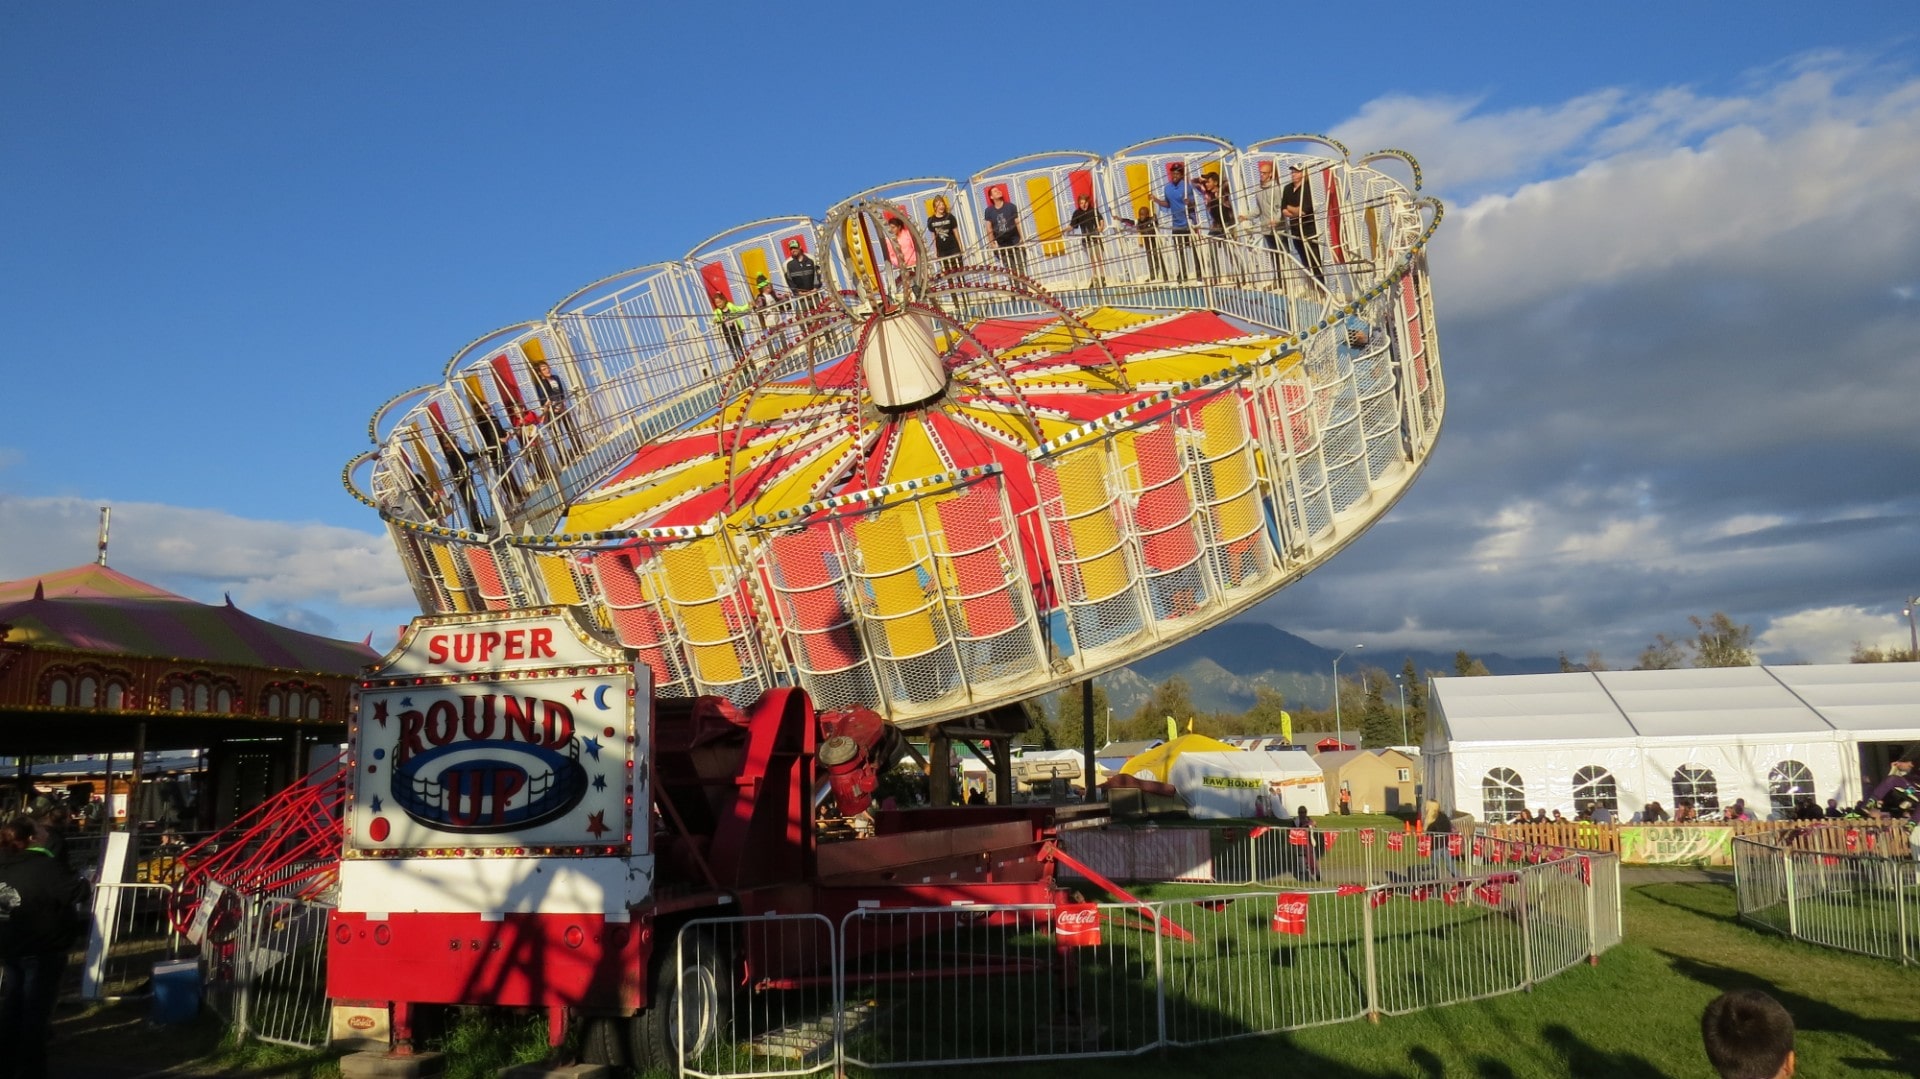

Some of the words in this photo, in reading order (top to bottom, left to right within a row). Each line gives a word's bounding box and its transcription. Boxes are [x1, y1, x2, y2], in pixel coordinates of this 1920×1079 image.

[429, 628, 557, 665] SUPER
[396, 694, 576, 764] ROUND
[1203, 776, 1225, 787] RAW
[1227, 779, 1262, 788] HONEY
[447, 768, 526, 827] UP
[1646, 827, 1703, 842] OASIS
[1057, 909, 1098, 925] Coca-Cola
